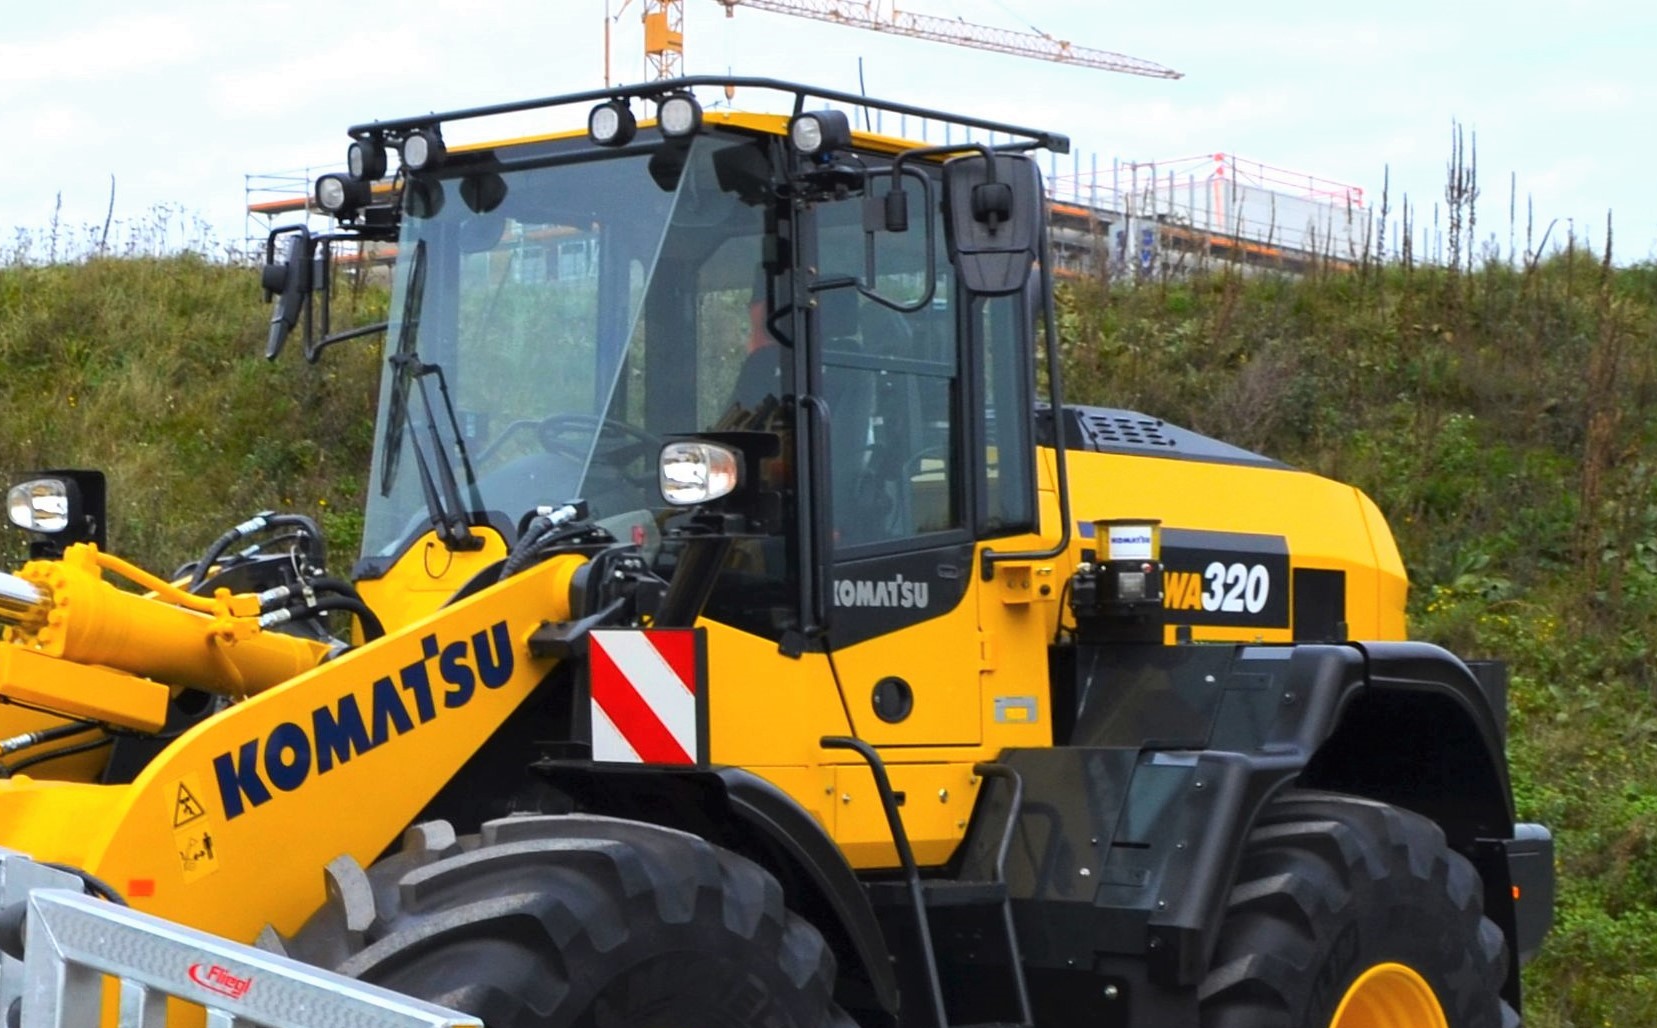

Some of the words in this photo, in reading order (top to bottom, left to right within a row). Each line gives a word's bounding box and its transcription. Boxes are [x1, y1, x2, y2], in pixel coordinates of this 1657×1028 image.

[1111, 536, 1150, 544] KOMATSU
[1164, 561, 1269, 614] WA320
[213, 619, 514, 822] KOMATSU
[206, 965, 253, 996] Fliegl
